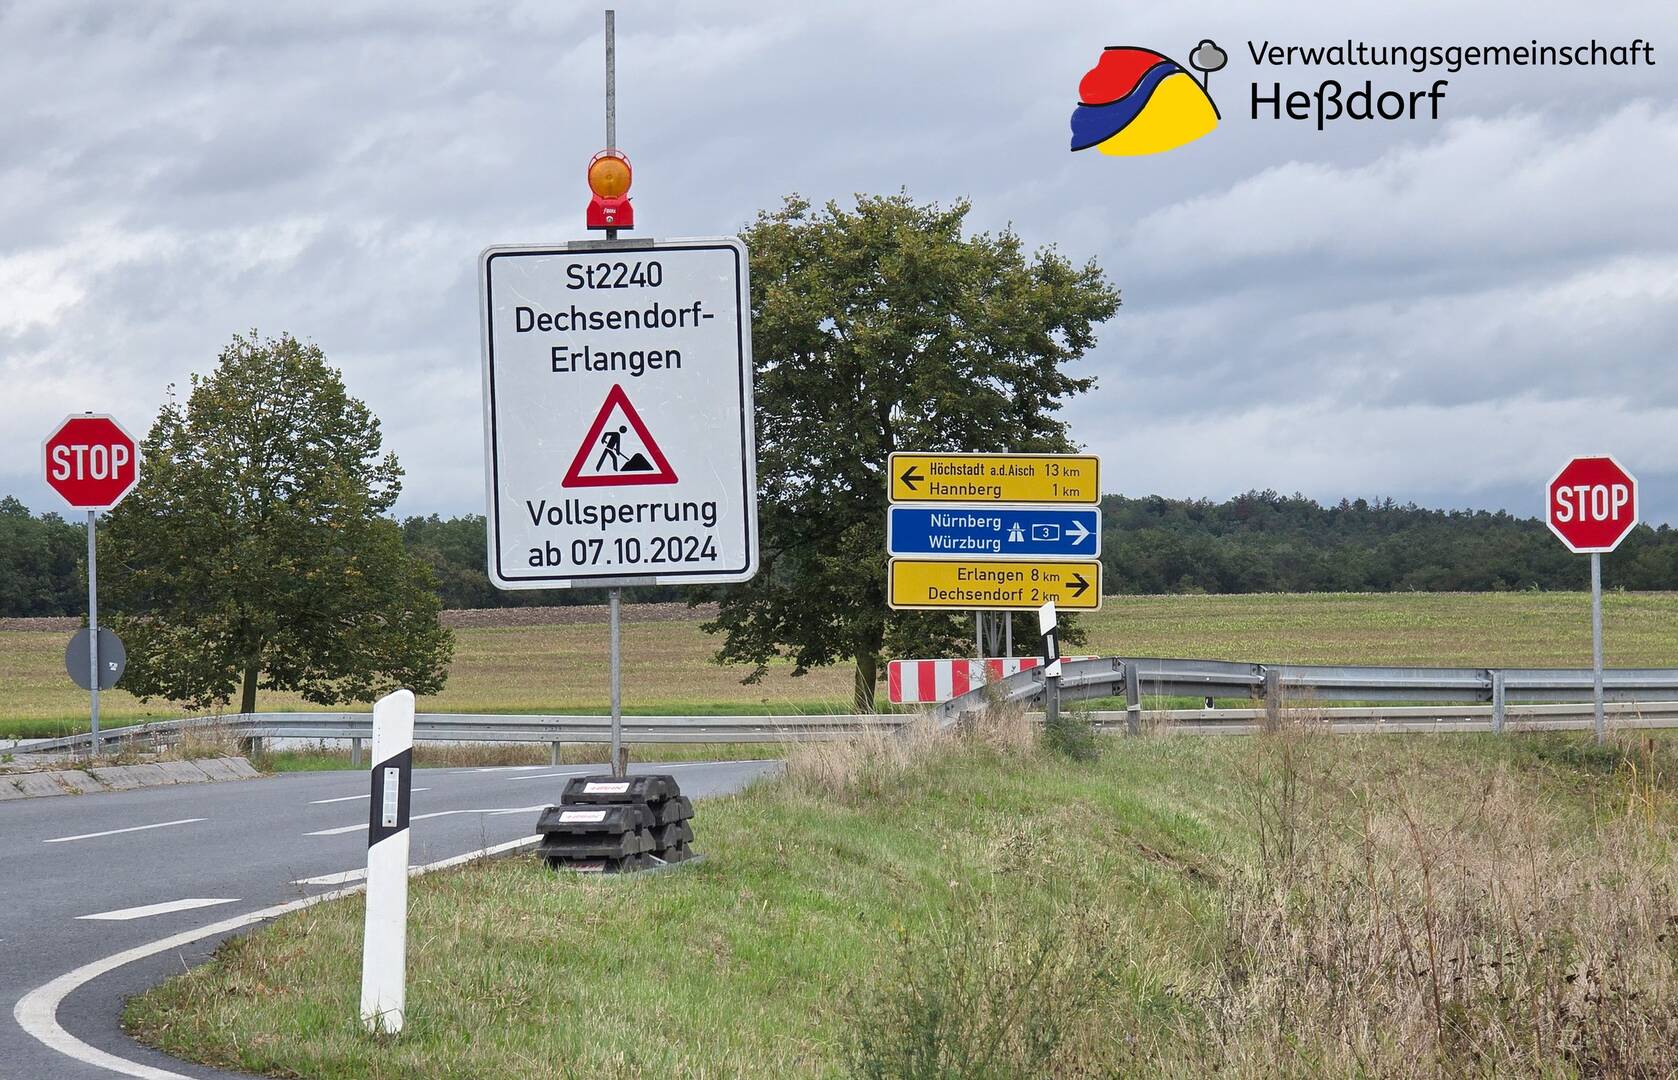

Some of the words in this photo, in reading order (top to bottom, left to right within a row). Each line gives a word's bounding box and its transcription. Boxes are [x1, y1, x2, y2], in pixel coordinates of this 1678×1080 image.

[566, 261, 663, 290] St2240
[515, 301, 715, 333] Dechsendorf-
[551, 346, 682, 377] Erlangen
[52, 444, 129, 481] STOP
[930, 462, 984, 476] Höchstadt
[1045, 463, 1059, 477] 13
[1063, 466, 1080, 477] km
[929, 482, 1001, 498] Hannberg
[1052, 483, 1058, 497] 1
[1063, 486, 1080, 497] km
[526, 499, 718, 531] Vollsperrung
[1556, 484, 1629, 523] STOP
[930, 514, 1001, 530] Nürnberg
[1042, 528, 1049, 538] 3
[528, 540, 561, 567] ab
[571, 535, 718, 566] 07.10.2024
[929, 535, 1001, 552] Würzburg
[957, 568, 1024, 584] Erlangen
[1031, 568, 1039, 581] 8
[1043, 571, 1060, 582] km
[928, 587, 1024, 601] Dechsendorf
[1031, 588, 1039, 601] 2
[1042, 591, 1060, 602] km
